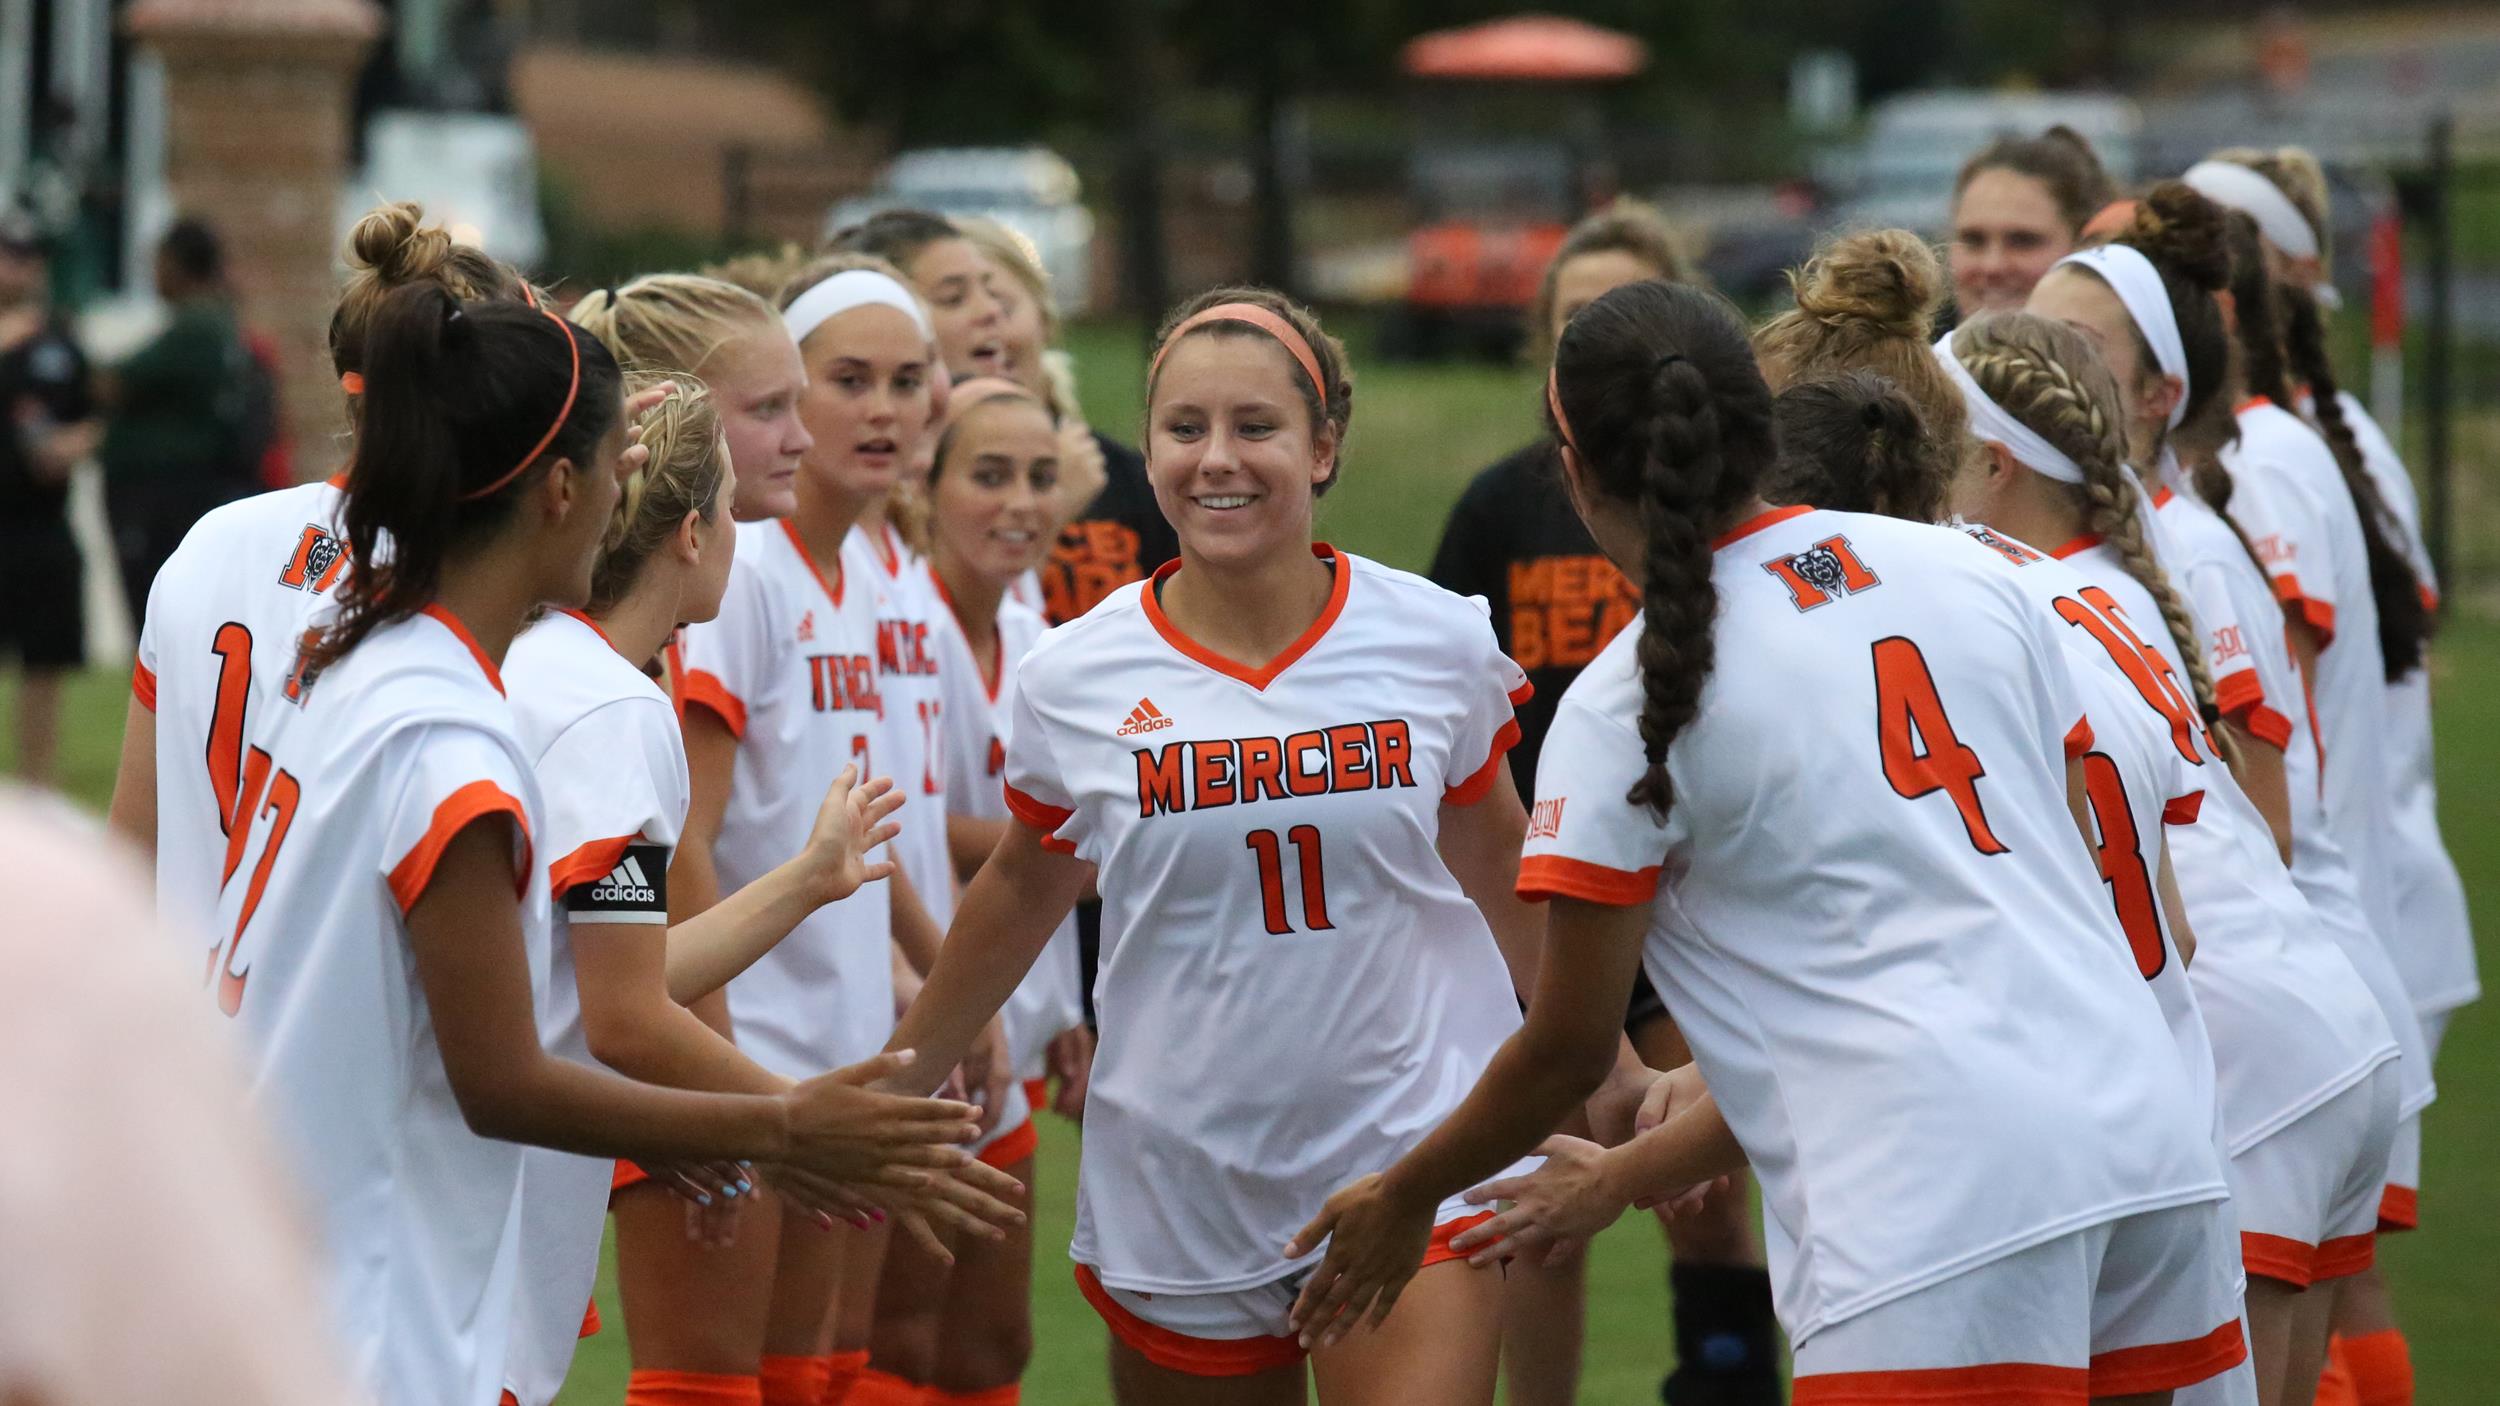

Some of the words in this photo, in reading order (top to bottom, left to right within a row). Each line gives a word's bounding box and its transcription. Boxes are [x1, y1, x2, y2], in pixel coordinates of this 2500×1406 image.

[1116, 717, 1174, 737] adidas
[1131, 718, 1418, 819] MERCER
[1871, 635, 2012, 857] 4
[591, 884, 656, 903] adidas
[1246, 823, 1337, 936] 11
